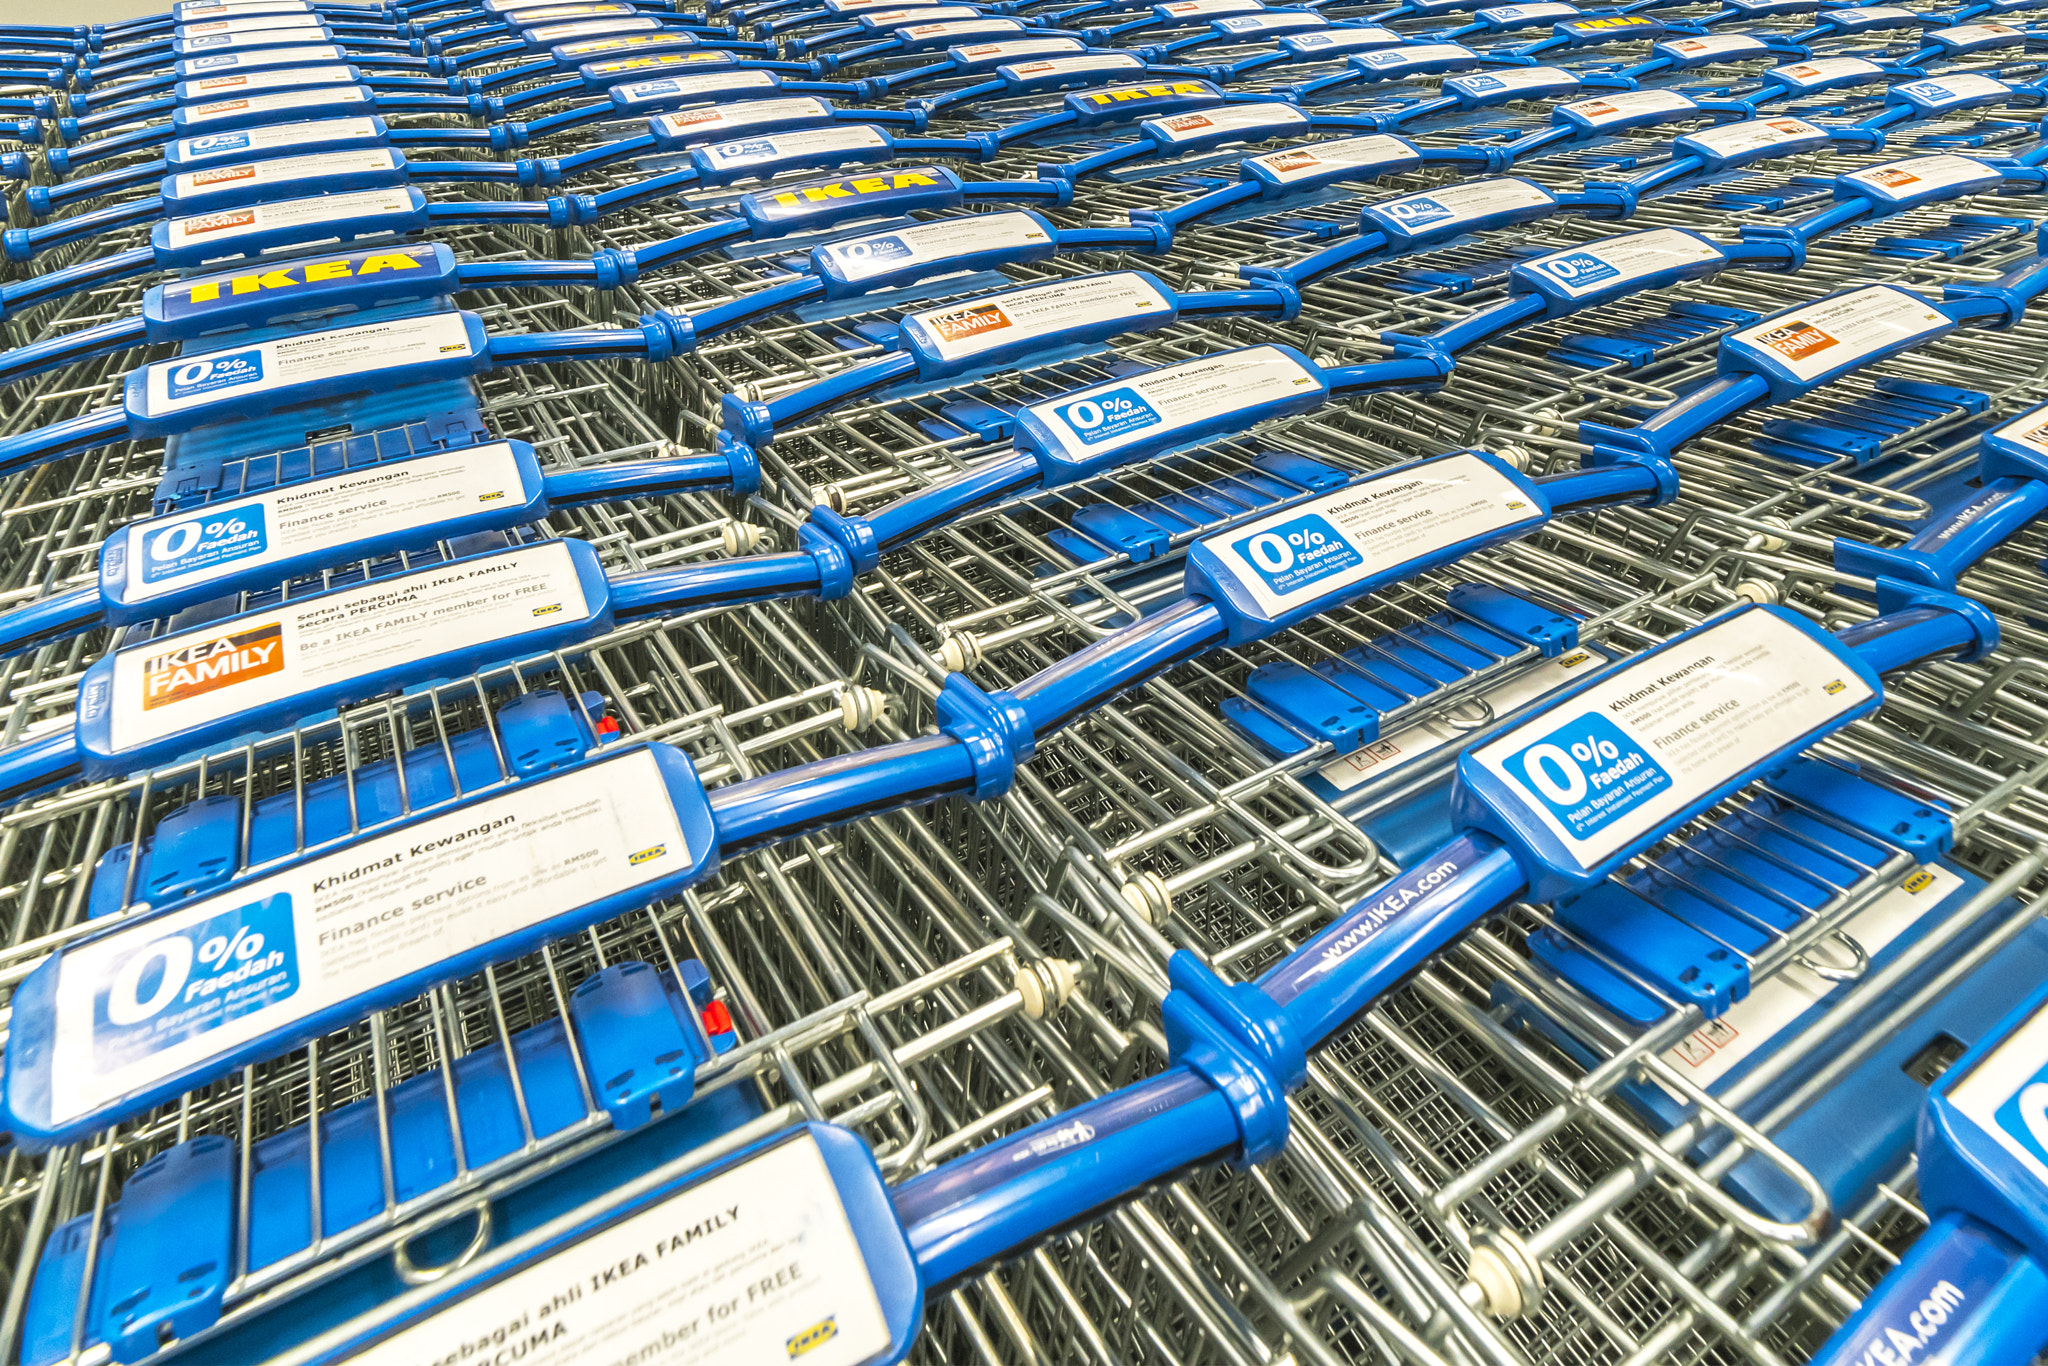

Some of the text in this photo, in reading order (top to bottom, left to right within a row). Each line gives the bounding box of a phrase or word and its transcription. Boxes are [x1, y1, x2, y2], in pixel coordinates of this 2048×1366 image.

[1573, 17, 1652, 30] IKEA
[605, 53, 720, 71] IKEA
[1091, 83, 1205, 104] IKEA
[196, 168, 253, 183] FAMILY
[773, 172, 938, 208] IKEA
[188, 213, 252, 233] FAMILY
[844, 243, 898, 261] 0%
[190, 253, 422, 304] IKEA
[1548, 260, 1603, 278] 0%
[1031, 293, 1065, 303] PERCUMA
[931, 311, 980, 327] IKEA
[938, 313, 1000, 336] FAMILY
[277, 328, 390, 349] Khidmat Kewangan
[1758, 328, 1799, 345] IKEA
[1775, 331, 1825, 355] FAMILY
[279, 347, 369, 366] Finance service
[175, 360, 248, 386] 0%
[209, 367, 256, 380] Faedah
[1139, 365, 1224, 388] Khidmat Kewangan
[1158, 385, 1227, 406] Finance service
[1068, 399, 1140, 429] 0%
[1084, 414, 1153, 438] Pelan Bayaran Ansuran
[1103, 407, 1147, 423] Faedah
[278, 472, 408, 504] Khidmat Kewangan
[1328, 482, 1423, 515] Khidmat Kewangan
[280, 501, 387, 529] Finance service
[1355, 510, 1433, 540] Finance service
[151, 520, 247, 562] 0%
[152, 541, 259, 573] Pelan Bayaran Ansuran
[197, 531, 258, 553] Faedah
[1250, 531, 1335, 573] 0%
[1298, 542, 1343, 564] Faedah
[1274, 552, 1352, 585] Pelan Bayaran Ansuran
[298, 563, 517, 621] Sertai sebagai ahli IKEA FAMILY
[299, 595, 417, 629] secara PERCUMA
[301, 643, 318, 651] Be
[337, 628, 370, 641] IKEA
[377, 612, 427, 630] FAMILY
[434, 599, 487, 616] member
[493, 593, 510, 601] for
[516, 585, 546, 596] FREE
[150, 639, 236, 676] IKEA
[150, 644, 275, 696] FAMILY
[1610, 657, 1714, 712] Khidmat Kewangan
[1654, 701, 1740, 749] Finance service
[1524, 738, 1635, 805] 0%
[1590, 753, 1643, 789] Faedah
[1568, 769, 1656, 824] Pelan Bayaran Ansuran
[1585, 812, 1607, 826] Interest
[1632, 782, 1654, 797] Payment
[1653, 776, 1665, 784] Plan
[314, 816, 515, 893] Khidmat Kewangan
[565, 850, 599, 865] RM500
[320, 878, 486, 945] Finance service
[1322, 861, 1458, 960] www.IKEA.com
[107, 928, 266, 1033] 0%
[185, 952, 284, 1003] Faedah
[156, 972, 287, 1034] Bayaran Ansuran
[539, 1203, 739, 1320] ahli IKEA FAMILY
[706, 1260, 803, 1326] for FREE
